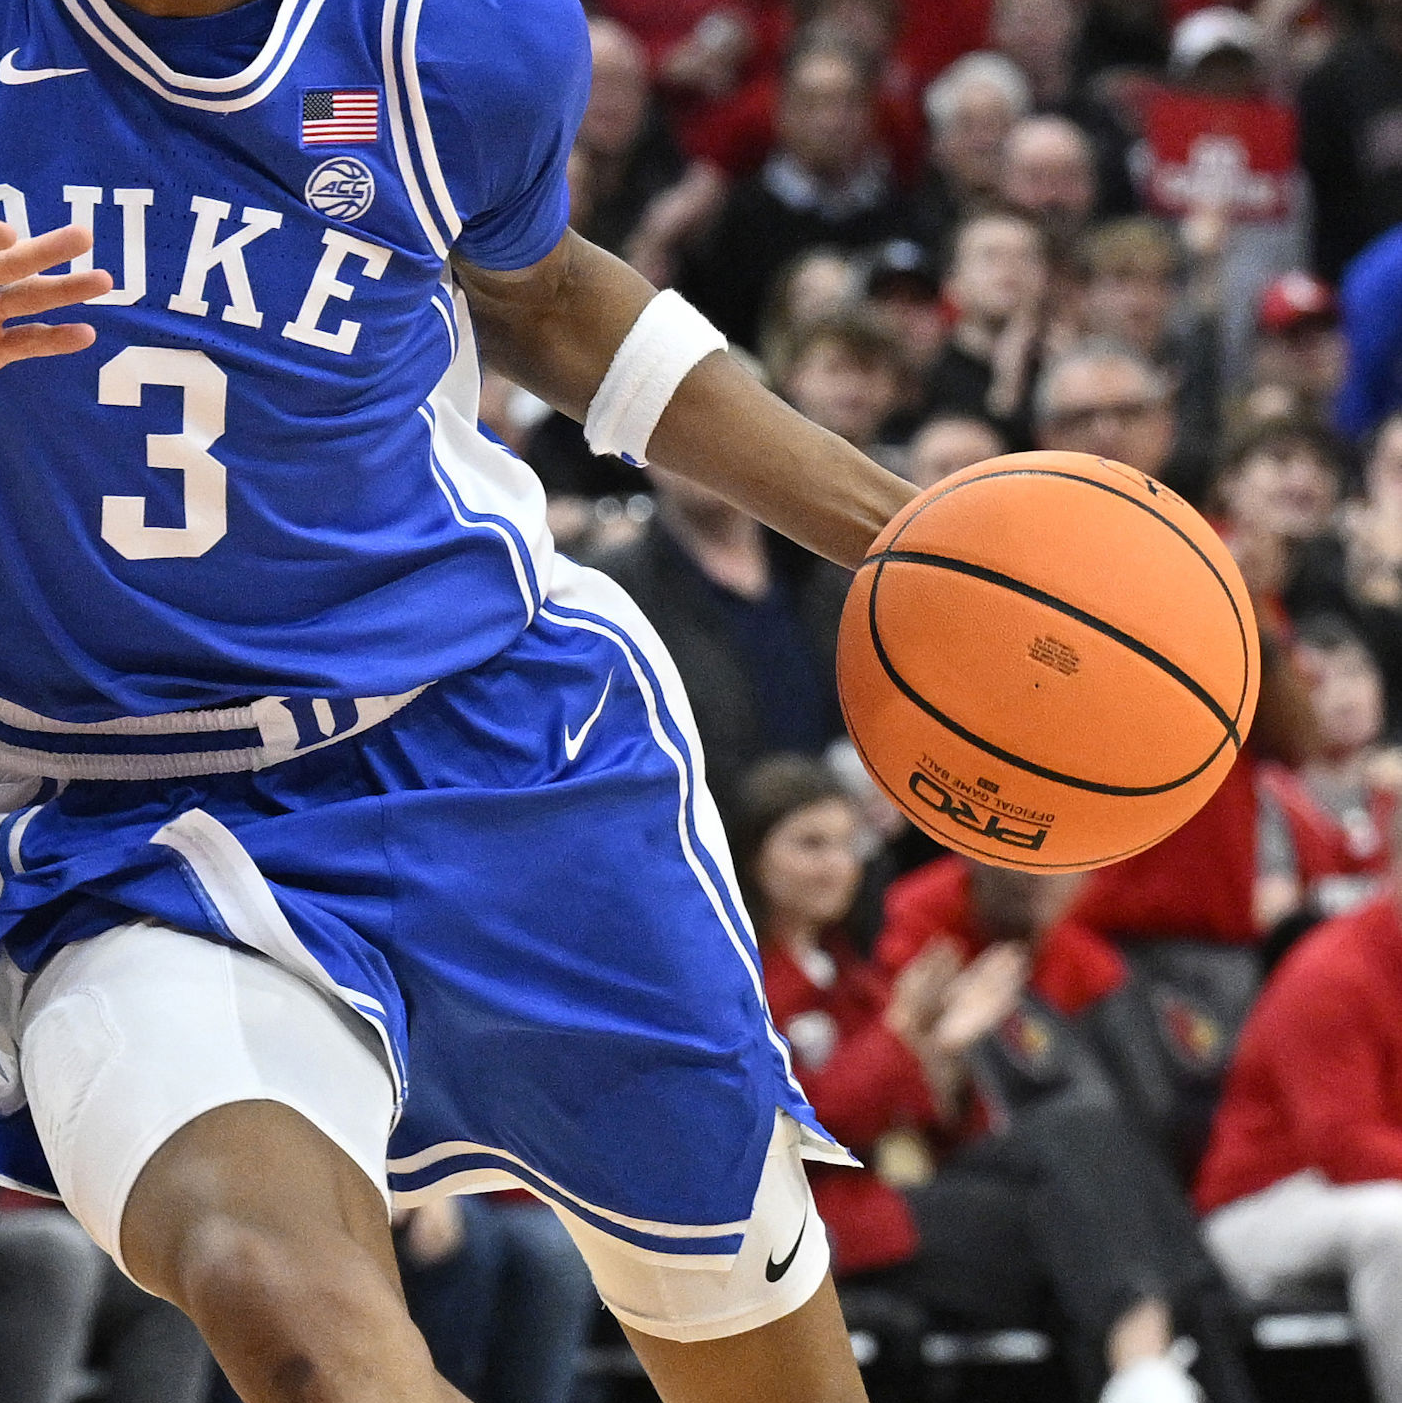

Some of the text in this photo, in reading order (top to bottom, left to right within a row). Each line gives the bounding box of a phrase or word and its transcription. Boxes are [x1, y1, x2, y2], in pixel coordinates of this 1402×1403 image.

[97, 345, 228, 561] 3
[921, 753, 951, 781] BALL
[951, 779, 989, 802] GAME
[908, 771, 1048, 851] PRO
[993, 797, 1055, 823] OFFICIAL
